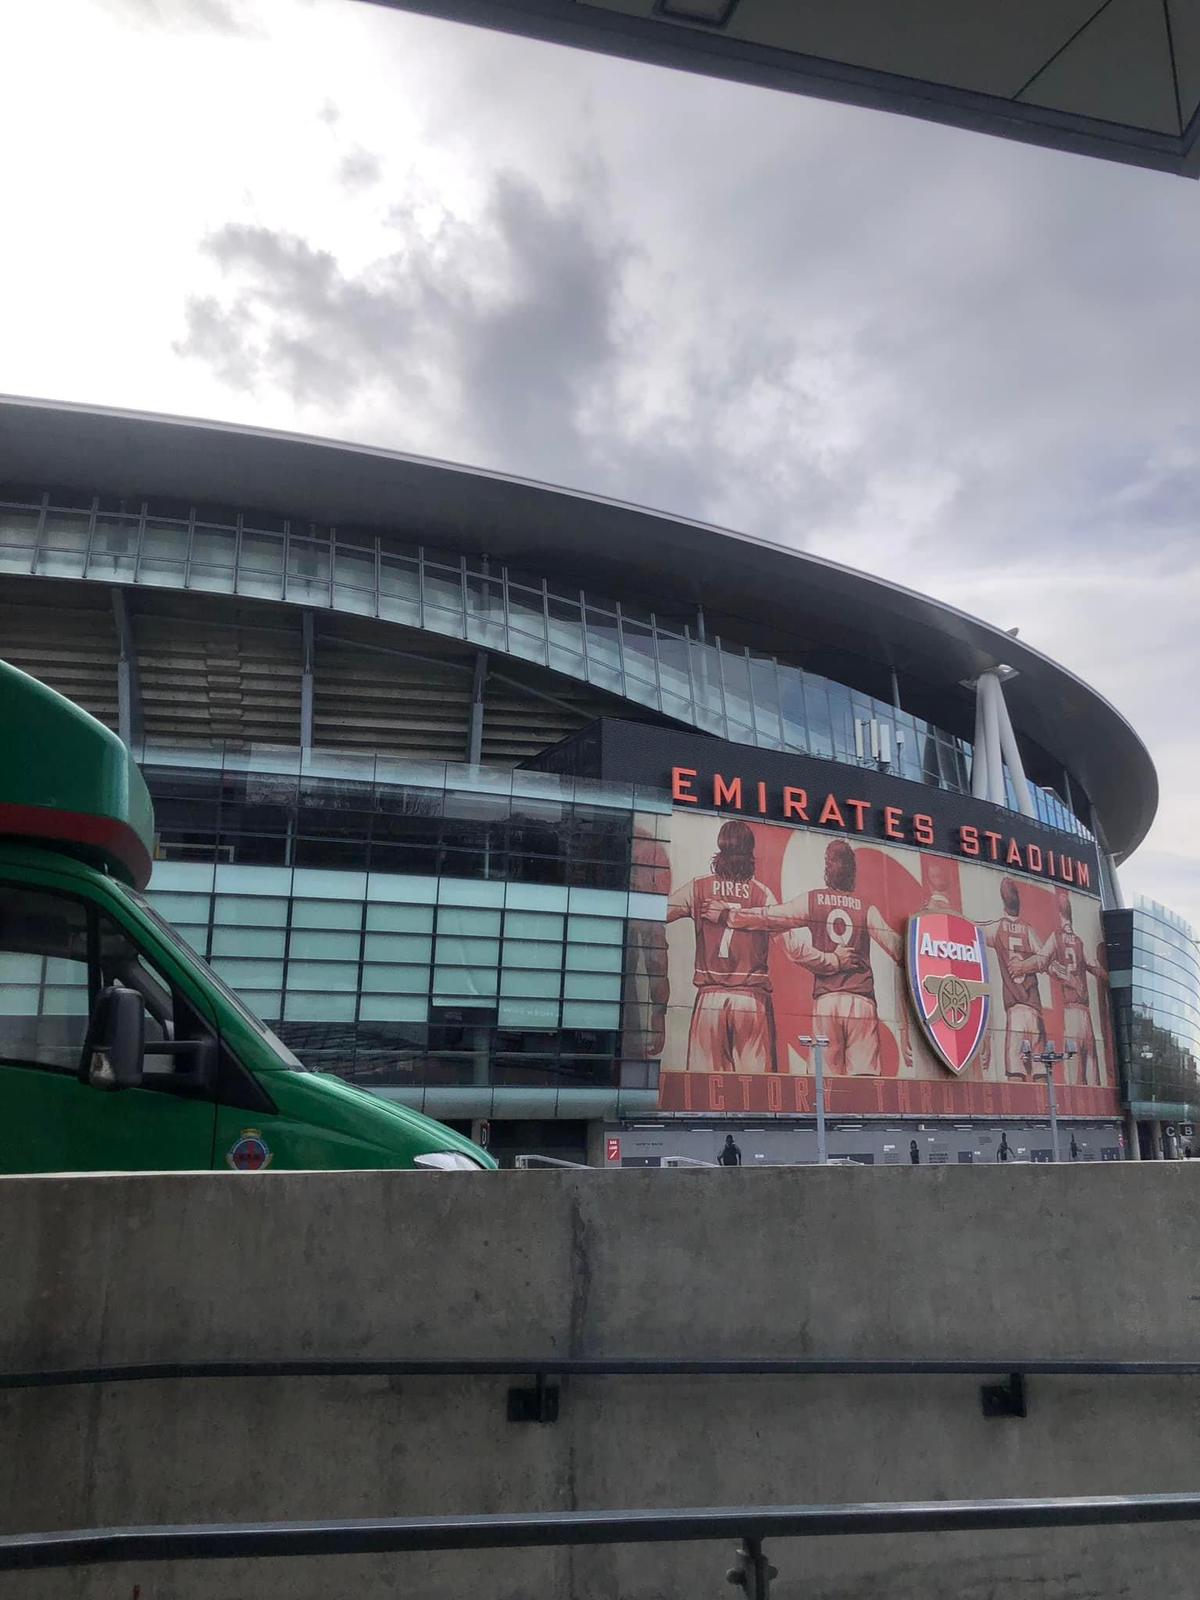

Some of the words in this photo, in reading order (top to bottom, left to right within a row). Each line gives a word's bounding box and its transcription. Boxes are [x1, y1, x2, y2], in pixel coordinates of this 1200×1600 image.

[671, 766, 934, 845] EMIRATES
[960, 825, 1091, 888] STADIUM
[713, 881, 750, 899] PIRES
[816, 893, 862, 910] RADFORD
[920, 933, 981, 963] Arsenal
[1166, 1126, 1176, 1137] C
[1185, 1126, 1193, 1136] B
